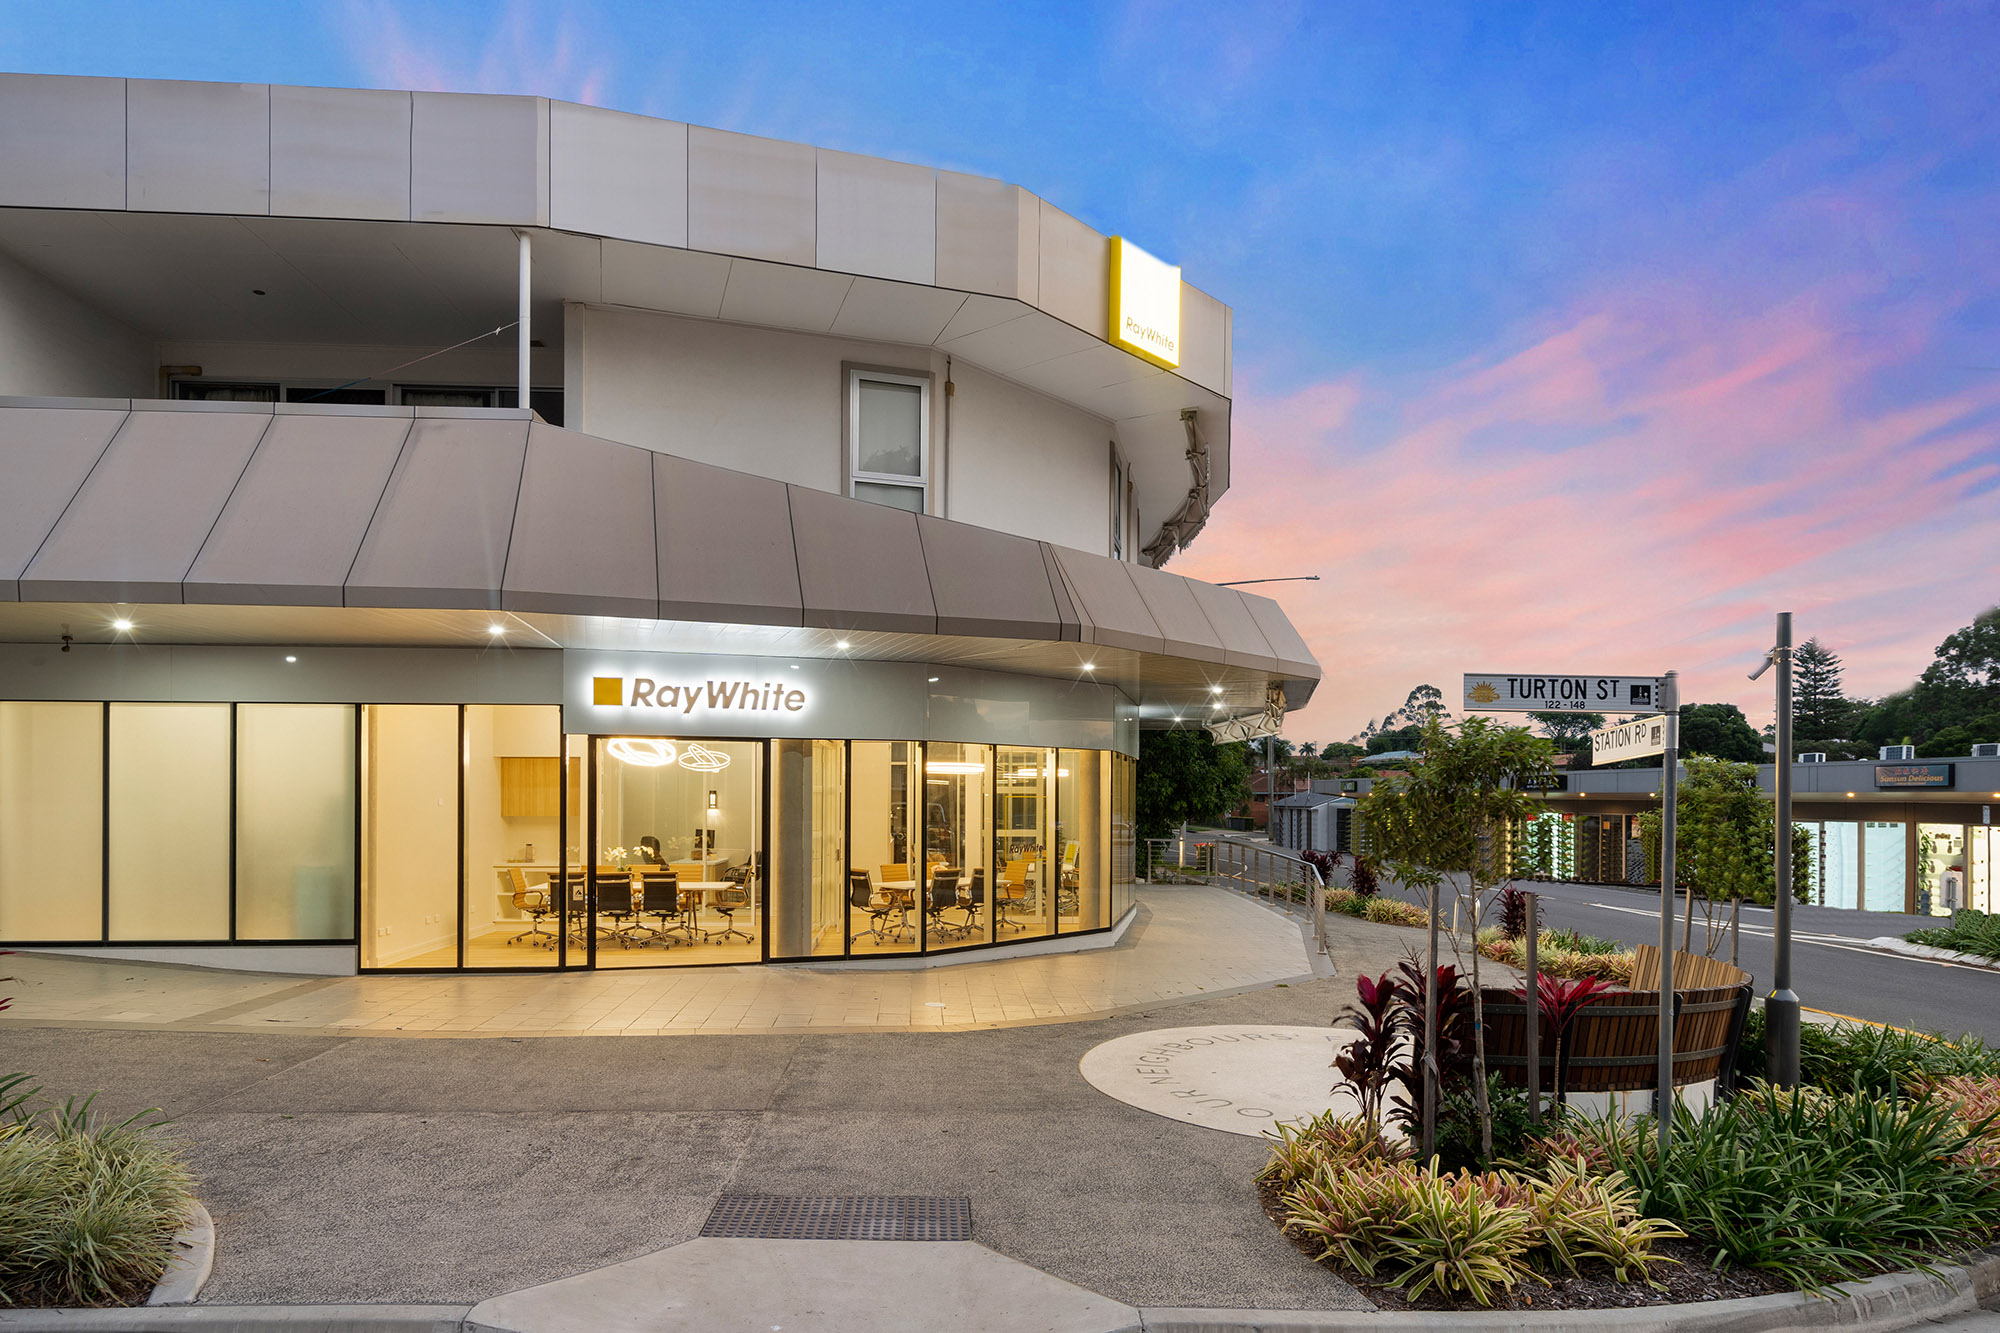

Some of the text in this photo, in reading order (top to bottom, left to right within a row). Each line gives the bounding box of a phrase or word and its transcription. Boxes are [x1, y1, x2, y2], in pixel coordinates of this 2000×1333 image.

[1507, 678, 1620, 700] TURTON ST
[1545, 700, 1561, 709] 122
[1570, 700, 1586, 709] 148
[1594, 723, 1647, 752] STATION RD
[1908, 774, 1944, 782] Delicious
